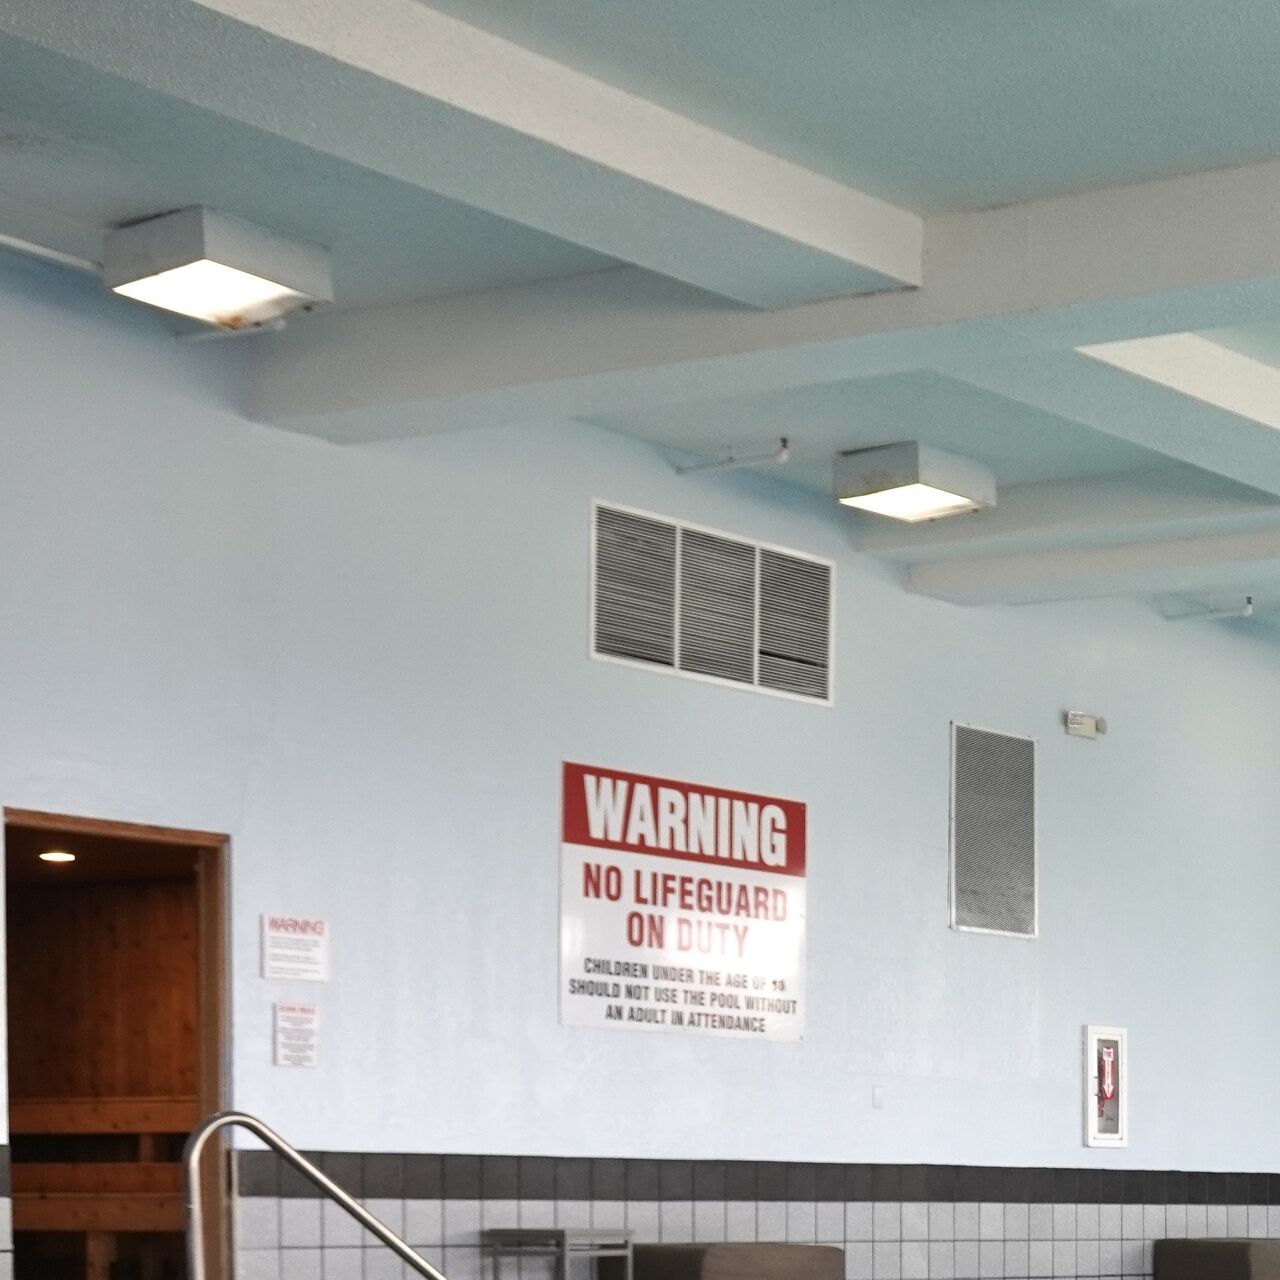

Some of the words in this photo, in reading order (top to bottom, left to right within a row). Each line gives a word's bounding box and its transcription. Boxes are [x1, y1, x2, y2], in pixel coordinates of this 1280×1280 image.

[583, 774, 788, 867] WARNING
[583, 862, 622, 901] NO
[633, 870, 787, 921] LIFEGUARD
[268, 917, 325, 936] WARNING
[627, 911, 664, 948] ON
[677, 917, 749, 957] DUTY
[584, 957, 647, 978] CHILDREN
[653, 964, 694, 984] UNDER
[699, 969, 720, 986] THE
[725, 973, 748, 989] AGE
[752, 976, 767, 990] OF
[569, 978, 620, 998] SHOULD
[624, 984, 649, 1001] NOT
[654, 988, 677, 1004] USE
[684, 990, 705, 1006] THE
[710, 993, 740, 1010] POOL
[745, 996, 797, 1015] WITHOUT
[605, 1005, 623, 1021] AN
[627, 1007, 667, 1025] ADULT
[671, 1011, 684, 1026] IN
[688, 1011, 766, 1033] ATTENDANCE
